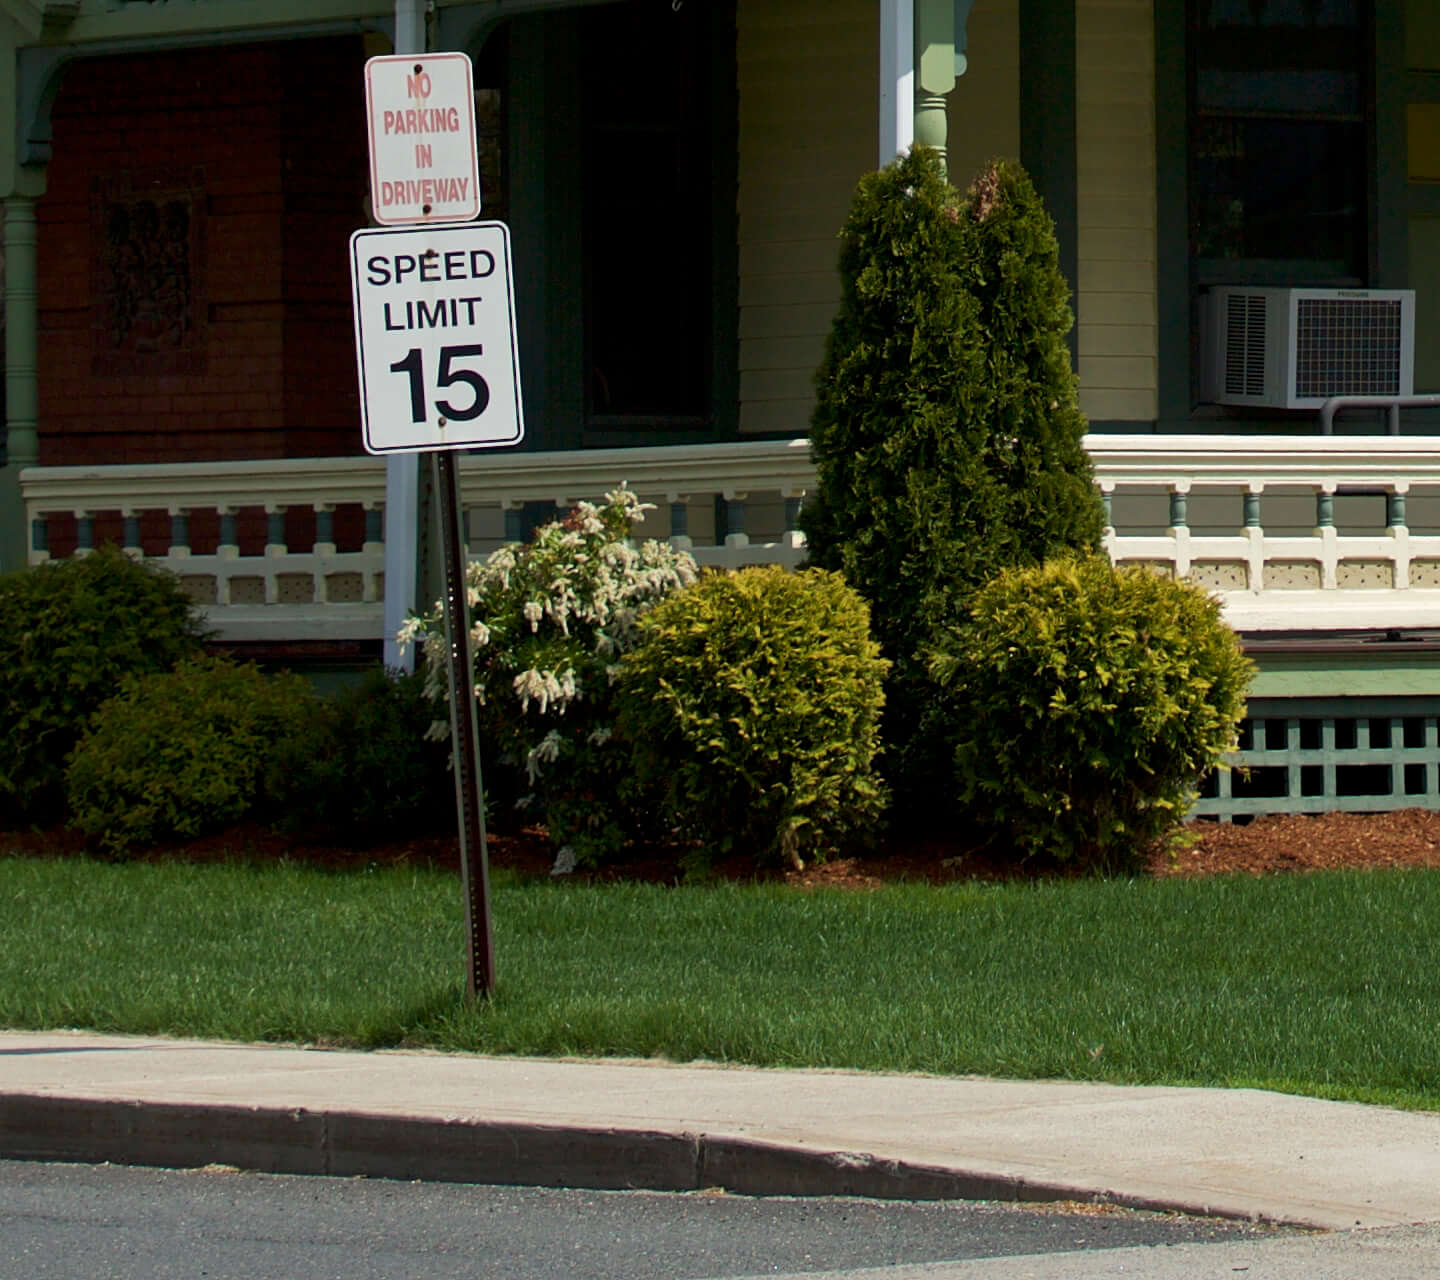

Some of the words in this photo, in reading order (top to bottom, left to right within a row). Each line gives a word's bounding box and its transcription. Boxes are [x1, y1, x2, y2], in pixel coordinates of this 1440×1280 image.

[407, 73, 432, 99] NO
[384, 107, 460, 135] PARKING
[415, 144, 433, 169] IN
[382, 177, 469, 206] DRIVEWAY
[367, 249, 496, 287] SPEED
[383, 297, 482, 331] LIMIT
[389, 343, 490, 424] 15
